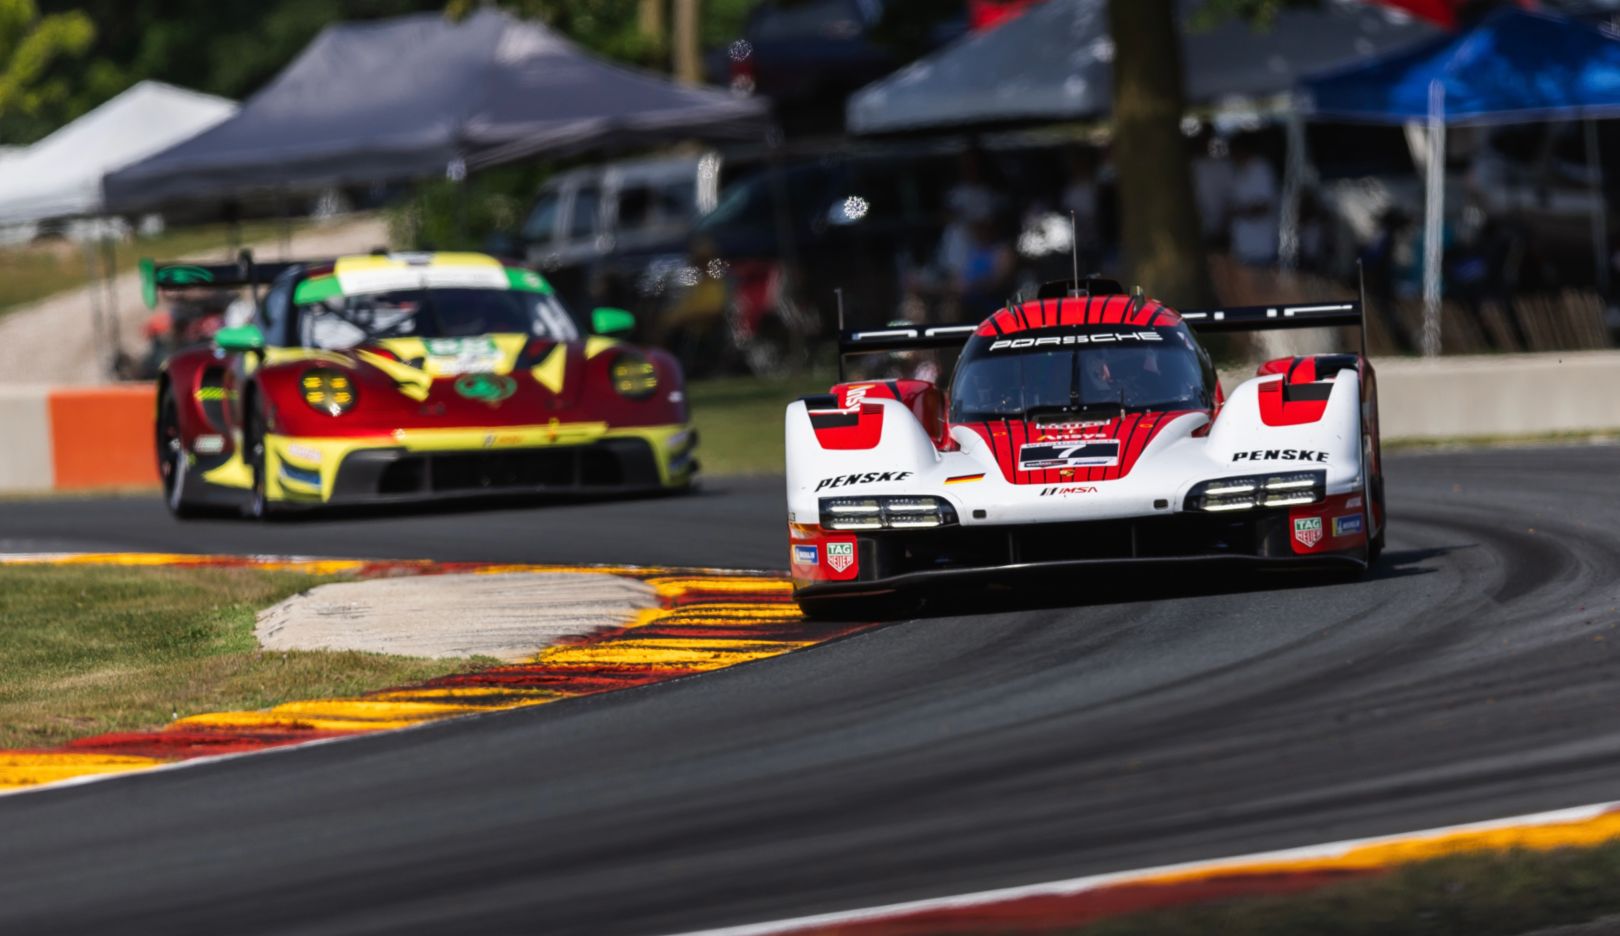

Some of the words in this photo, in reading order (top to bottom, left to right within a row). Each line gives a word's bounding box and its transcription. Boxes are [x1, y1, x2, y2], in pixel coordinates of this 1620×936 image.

[989, 331, 1163, 350] PORSCHE
[1037, 433, 1107, 441] Ansys
[1052, 444, 1087, 459] 7
[1232, 449, 1330, 463] PENSKE
[814, 471, 915, 492] PENSKE
[1059, 486, 1098, 495] IMSA
[1297, 519, 1320, 530] TAG
[829, 544, 851, 555] TAG
